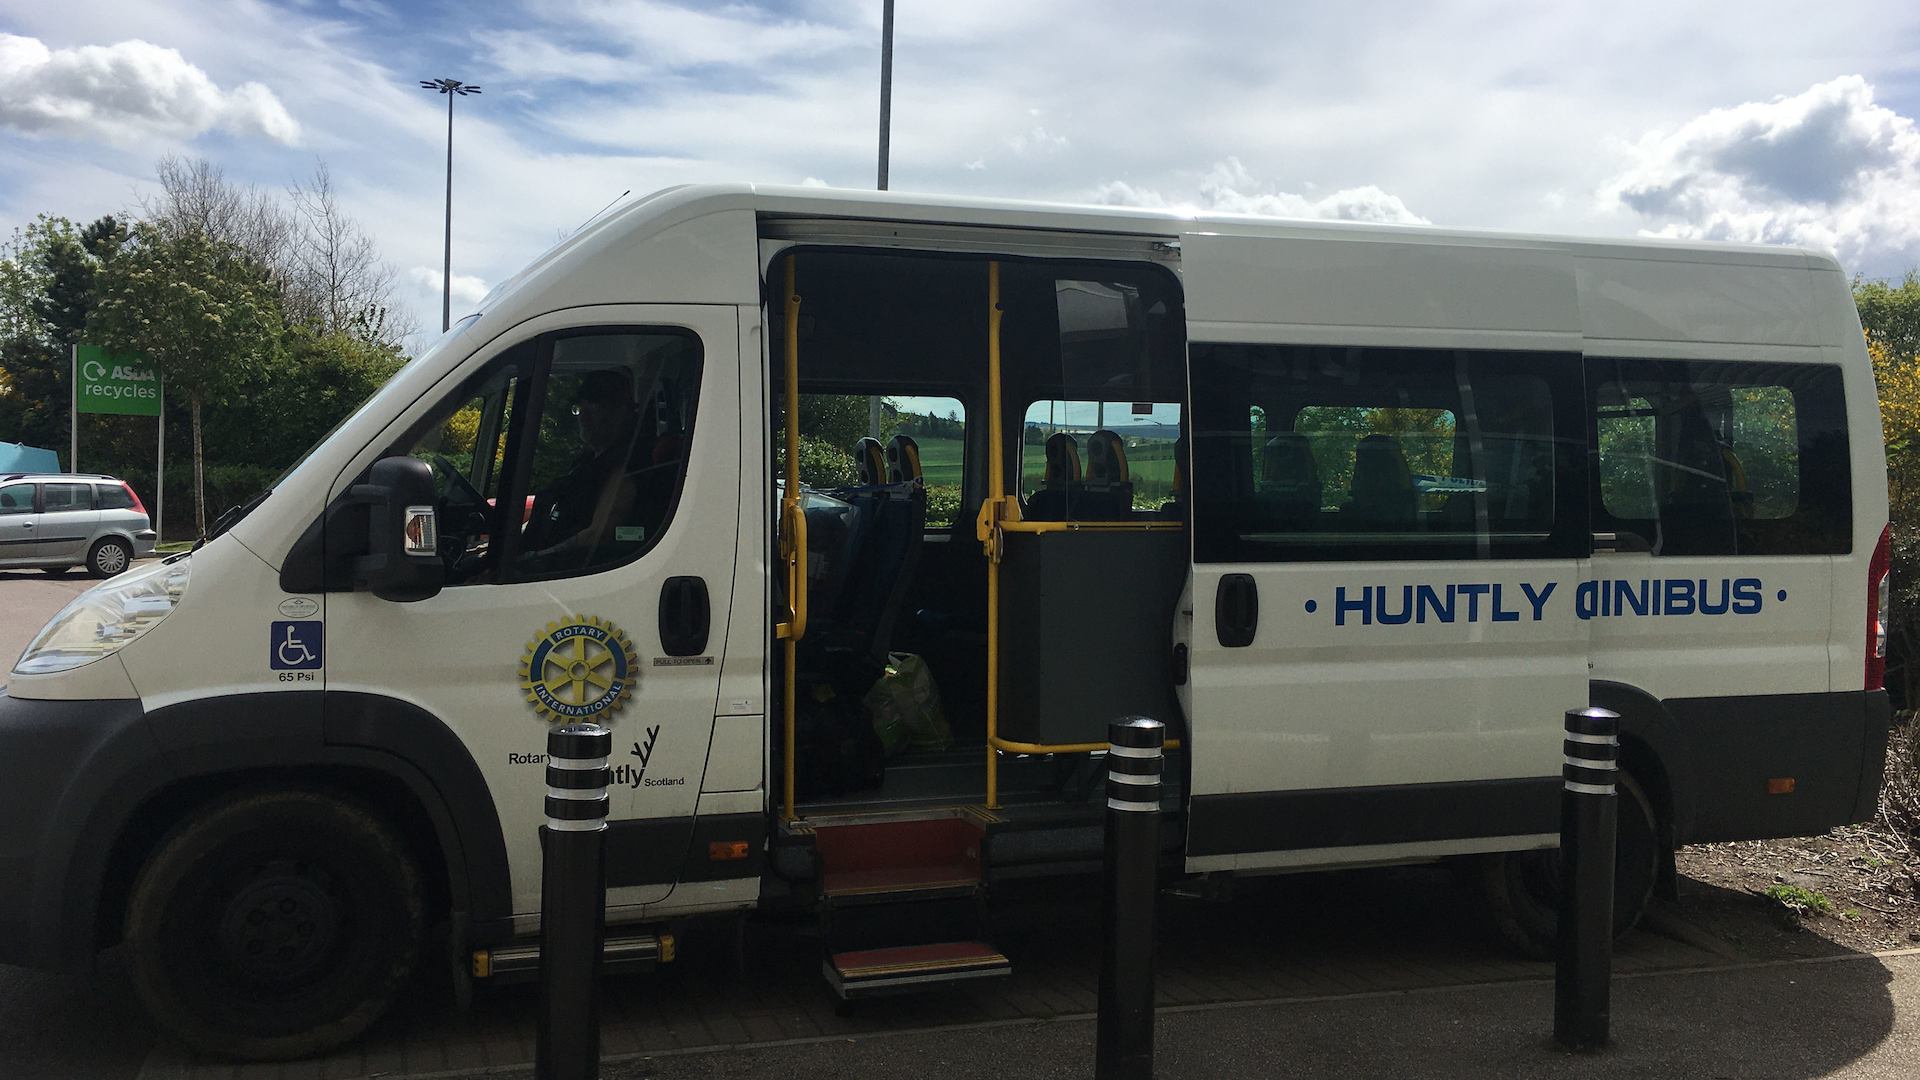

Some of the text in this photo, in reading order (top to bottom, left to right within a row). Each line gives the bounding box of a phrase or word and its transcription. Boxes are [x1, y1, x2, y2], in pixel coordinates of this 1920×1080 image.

[85, 384, 156, 399] recycles
[1335, 578, 1763, 626] HUNTLY INIBUS
[556, 626, 604, 640] ROTARY
[279, 672, 314, 682] 65 Psi
[536, 684, 621, 715] INTERNATIONAL
[644, 777, 685, 787] Scotland
